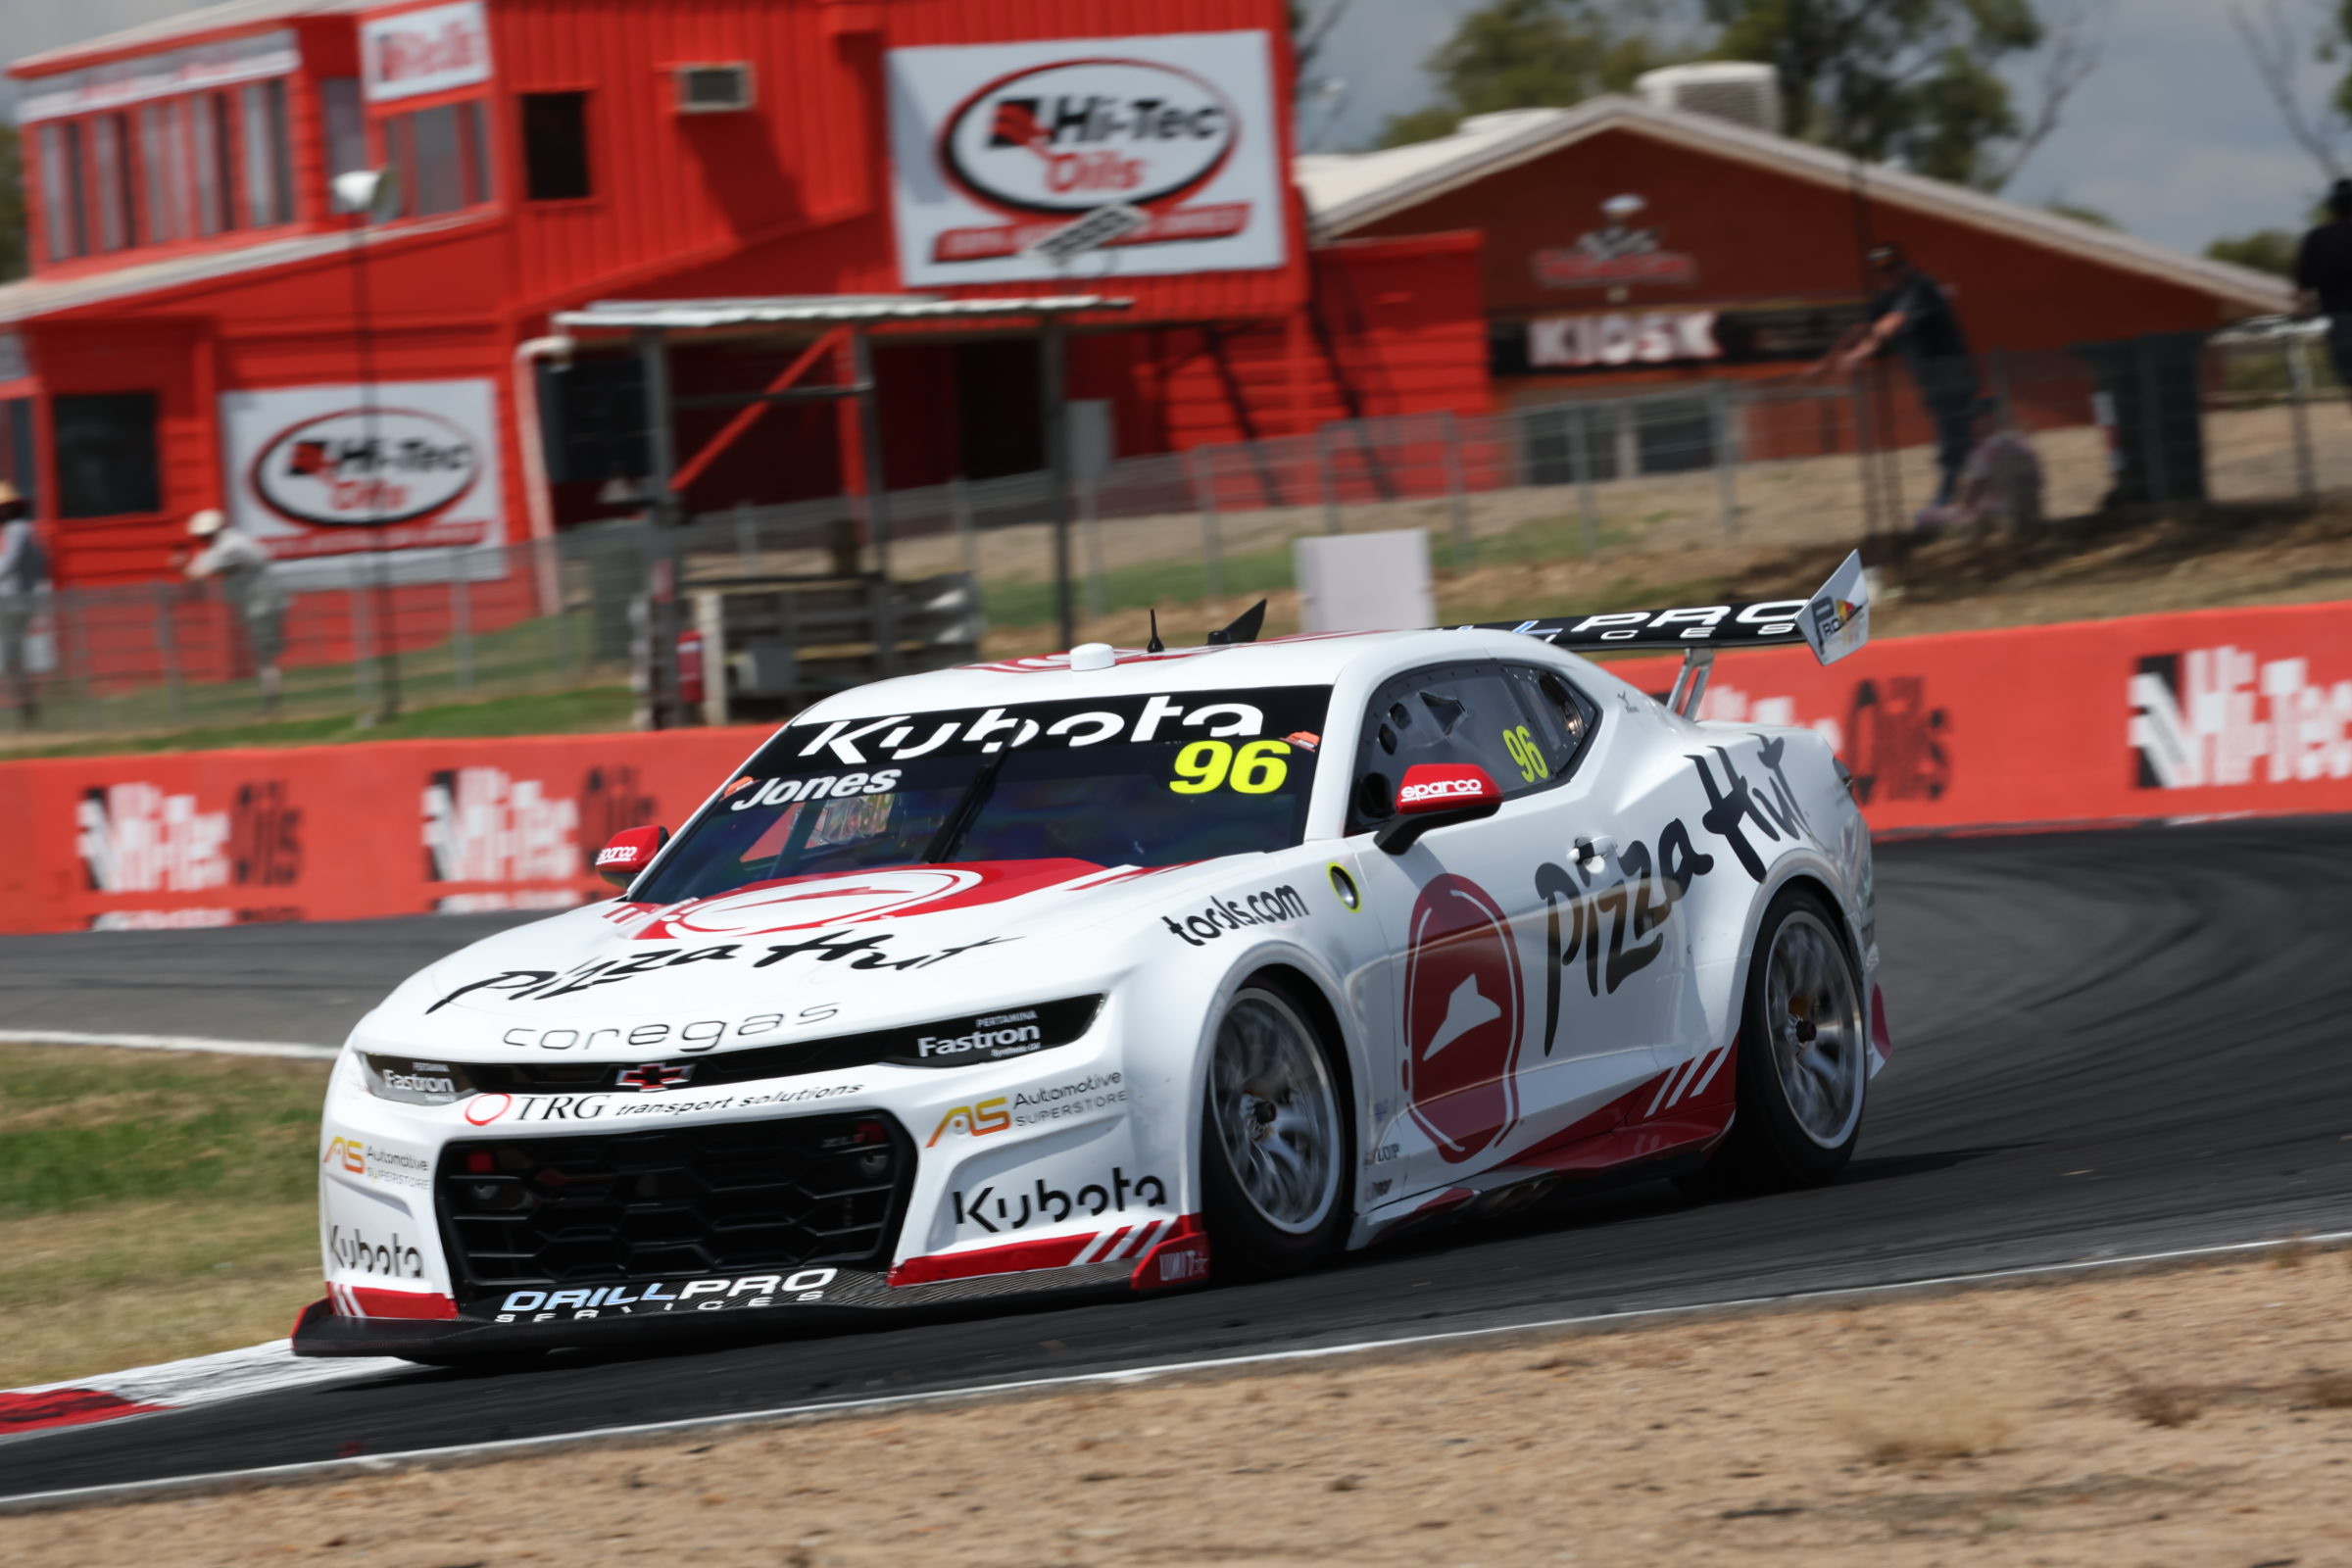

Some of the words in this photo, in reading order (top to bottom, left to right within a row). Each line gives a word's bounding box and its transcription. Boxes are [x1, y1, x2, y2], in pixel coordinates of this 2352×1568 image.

[1049, 95, 1225, 146] Hi-Tec
[1045, 149, 1152, 194] Oils
[1527, 311, 1723, 367] KIOSK
[799, 695, 1264, 765] Kubota
[1502, 725, 1548, 783] 96
[731, 766, 903, 811] Jones
[1168, 740, 1292, 796] 96
[1400, 778, 1483, 802] sparco
[1535, 816, 1715, 1058] Pizza
[1683, 732, 1813, 884] Hut
[424, 942, 737, 1015] Pizza
[753, 928, 1027, 973] Hut
[502, 1002, 840, 1053] coregas
[917, 1024, 1041, 1058] Fastron
[382, 1068, 455, 1094] Fastron
[514, 1093, 612, 1121] TRG
[615, 1095, 732, 1117] transport
[741, 1082, 864, 1107] solutions
[1013, 1071, 1122, 1109] Automotive
[1014, 1090, 1128, 1127] SUPERSTORE
[367, 1145, 431, 1171] Automotive
[952, 1166, 1167, 1233] Kubota
[326, 1225, 425, 1278] Kubota
[501, 1267, 838, 1312] DRILLPRO
